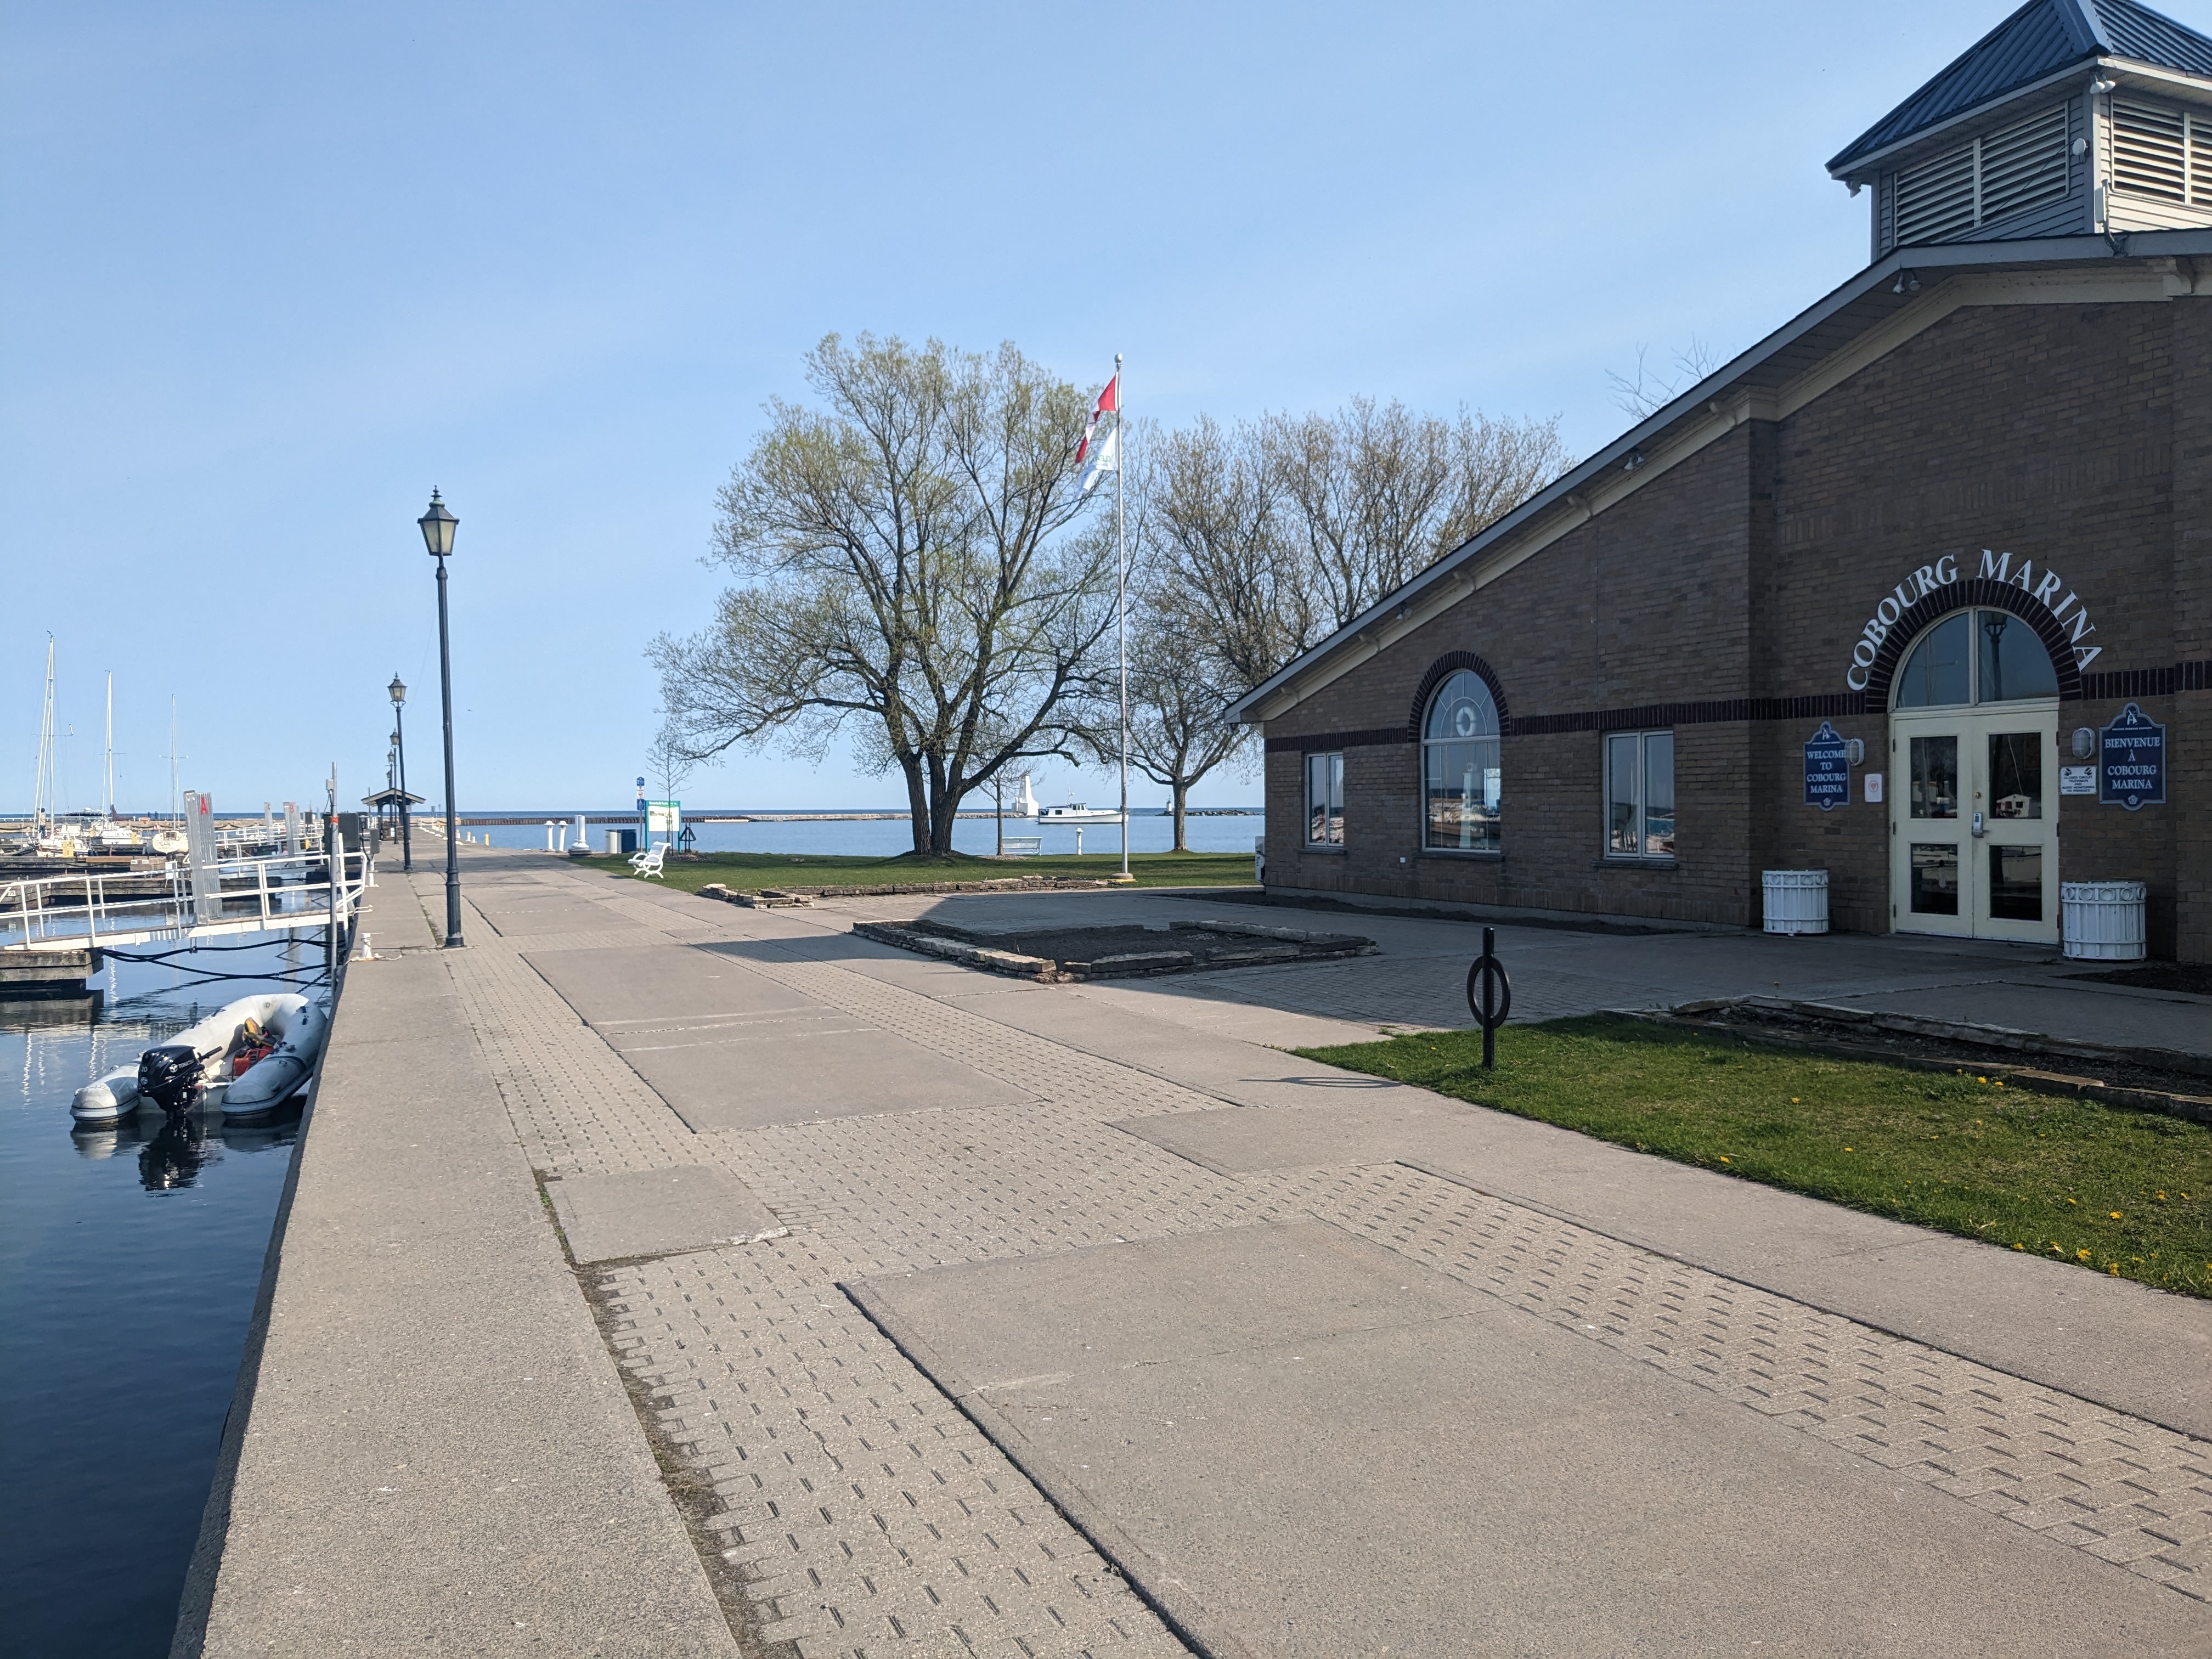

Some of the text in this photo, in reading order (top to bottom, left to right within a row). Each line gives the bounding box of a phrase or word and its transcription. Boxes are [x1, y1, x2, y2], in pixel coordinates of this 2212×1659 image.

[1847, 549, 2102, 691] COBOURG MARINA
[2104, 737, 2160, 748] BIENVENUE
[1806, 750, 1846, 759] WELCOME
[1820, 762, 1832, 770] TO
[2107, 765, 2157, 776] COBOURG
[1806, 773, 1846, 782] COBOURG
[1810, 785, 1843, 793] MARINA
[2112, 779, 2153, 789] MARINA
[200, 797, 208, 815] A
[289, 804, 294, 813] B
[178, 1059, 194, 1069] TOHATSU
